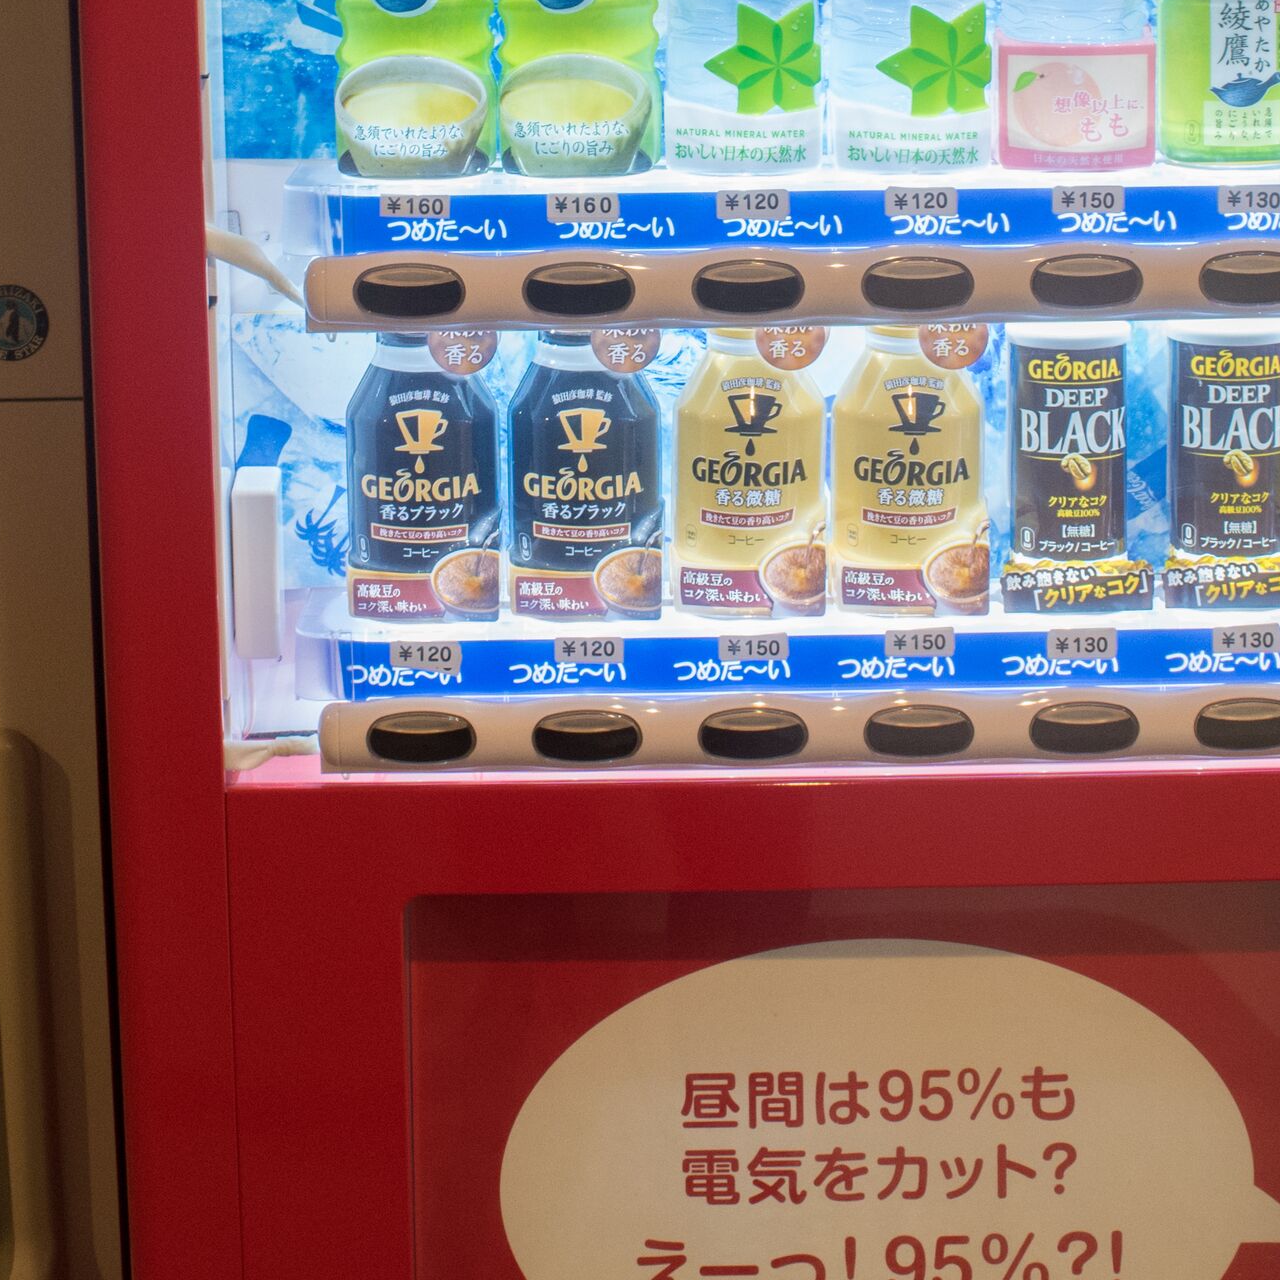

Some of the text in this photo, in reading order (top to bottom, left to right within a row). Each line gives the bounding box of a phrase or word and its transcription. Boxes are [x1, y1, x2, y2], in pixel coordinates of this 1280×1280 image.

[1217, 0, 1253, 68] 綾鷹
[1054, 90, 1145, 115] 想像以上に、
[676, 128, 806, 139] NATURAL MINERAL WATER
[1080, 113, 1129, 143] もも
[675, 142, 807, 164] おいしい日本の天然水
[554, 196, 612, 214] ¥160
[724, 193, 779, 211] ¥120
[1061, 191, 1115, 209] ¥150
[1227, 191, 1280, 208] ¥130
[445, 346, 484, 365] 香る
[607, 344, 646, 364] 香る
[769, 339, 806, 358] 香る
[1028, 352, 1121, 381] GEORGIA
[1045, 388, 1108, 408] DEEP
[1208, 384, 1270, 404] DEEP
[1020, 406, 1126, 454] BLACK
[692, 449, 807, 486] GEORGIA
[854, 449, 970, 486] GEORGIA
[361, 468, 479, 502] GEORGIA
[524, 467, 642, 501] GEORGIA
[716, 489, 782, 507] 香る微糖
[878, 488, 944, 507] 香る微糖
[1048, 495, 1107, 507] クリアなコク
[380, 503, 464, 521] 香るブラック
[542, 503, 626, 520] 香るブラック
[1062, 525, 1095, 538] 【無糖】
[403, 547, 439, 559] コーヒー
[1039, 539, 1115, 553] ブラック/コーヒー
[683, 571, 732, 586] 高級豆の
[1006, 567, 1096, 591] 飲み飽きない
[357, 583, 400, 598] 高級豆の
[519, 582, 563, 597] 高級豆の
[357, 599, 426, 613] コク深い味わい
[562, 639, 615, 658] ¥120
[893, 633, 946, 651] ¥150
[1055, 635, 1108, 653] ¥130
[397, 645, 452, 663] ¥120
[679, 1066, 1078, 1130] 昼間は95%も
[681, 1141, 1078, 1206] 電気をカット?
